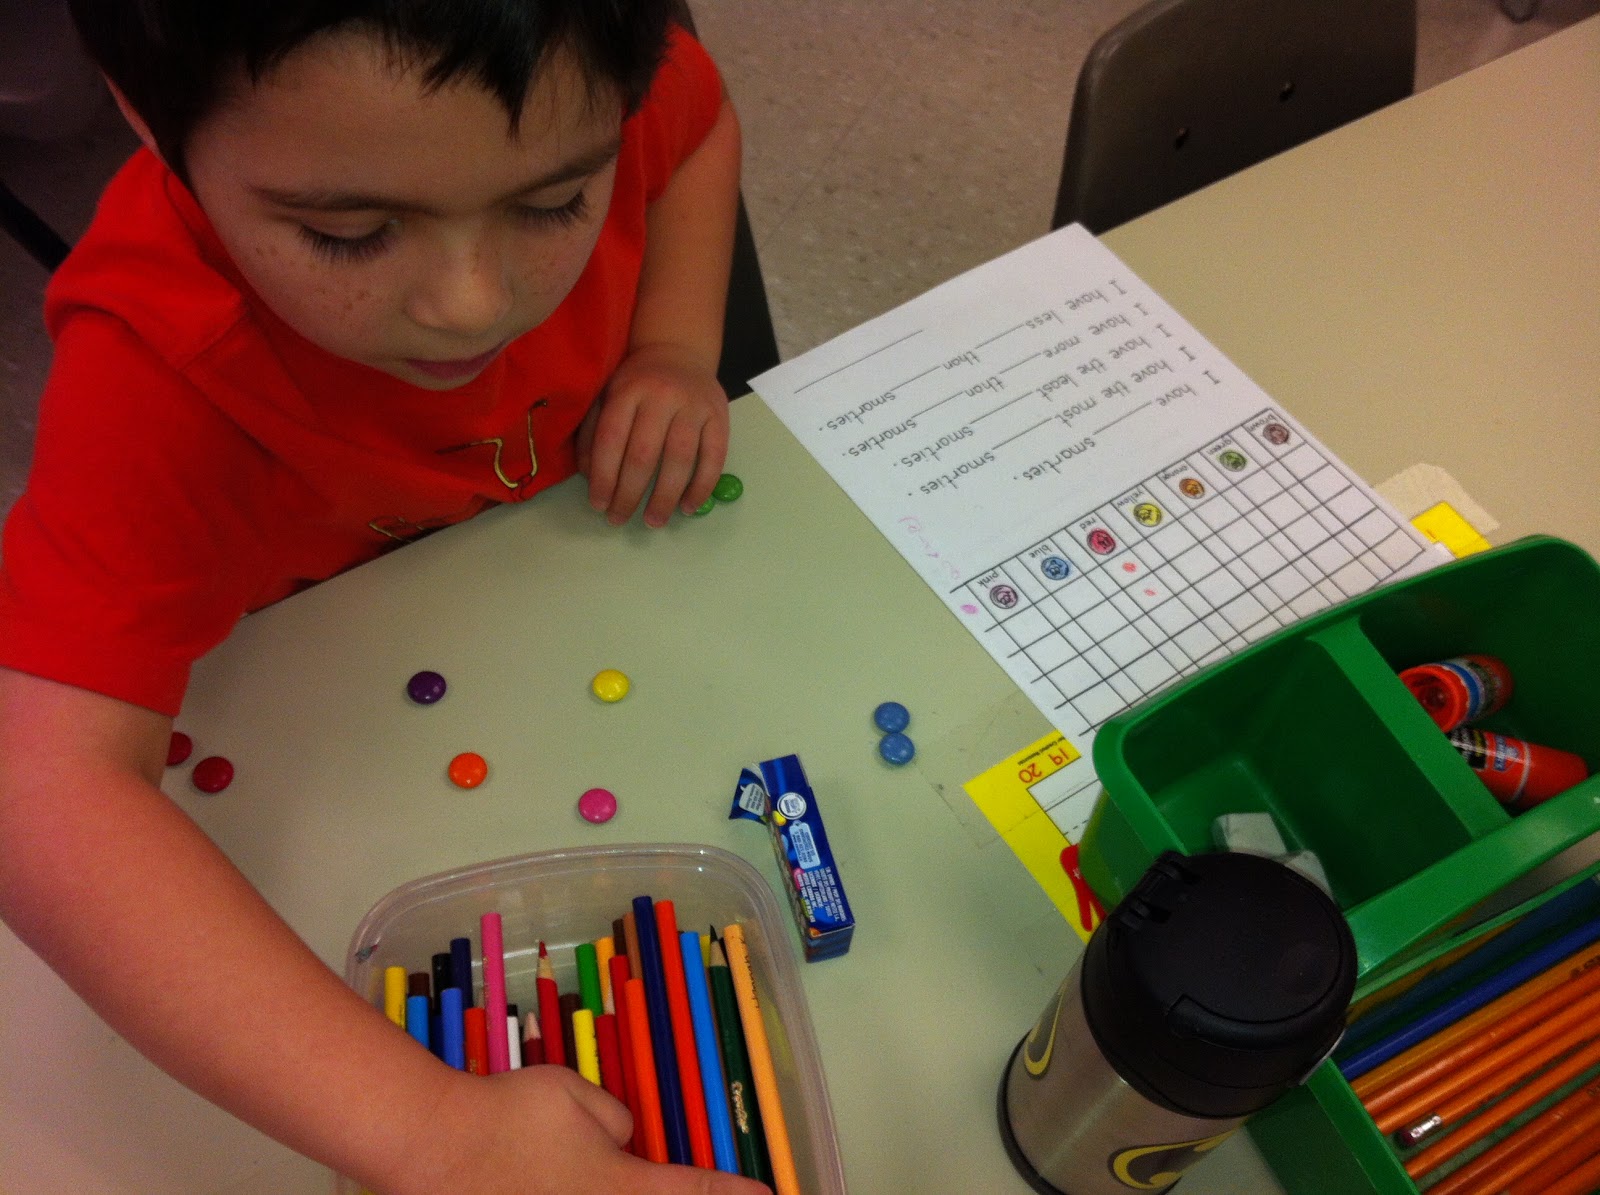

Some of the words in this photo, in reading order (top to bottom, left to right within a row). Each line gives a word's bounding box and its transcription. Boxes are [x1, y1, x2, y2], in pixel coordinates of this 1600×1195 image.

[1108, 280, 1128, 296] I
[1064, 290, 1108, 311] have
[1134, 302, 1149, 317] I
[1025, 310, 1064, 330] less
[1088, 314, 1132, 336] have
[1155, 323, 1173, 338] I
[1043, 336, 1081, 359] more
[1109, 336, 1153, 360] have
[1178, 345, 1197, 363] I
[942, 350, 981, 371] than
[1076, 358, 1108, 375] the
[1131, 360, 1174, 384] have
[1202, 370, 1222, 386] I
[964, 376, 1005, 398] than
[1036, 374, 1079, 402] least
[1101, 380, 1131, 399] the
[1155, 384, 1198, 407] have
[1054, 396, 1098, 428] most
[1246, 414, 1277, 432] brown
[1206, 436, 1233, 455] green
[1116, 486, 1145, 507] yellow
[1079, 517, 1097, 532] red
[1028, 544, 1053, 559] blue
[977, 568, 1000, 589] pink
[1048, 747, 1070, 766] 19
[1018, 763, 1042, 783] 20
